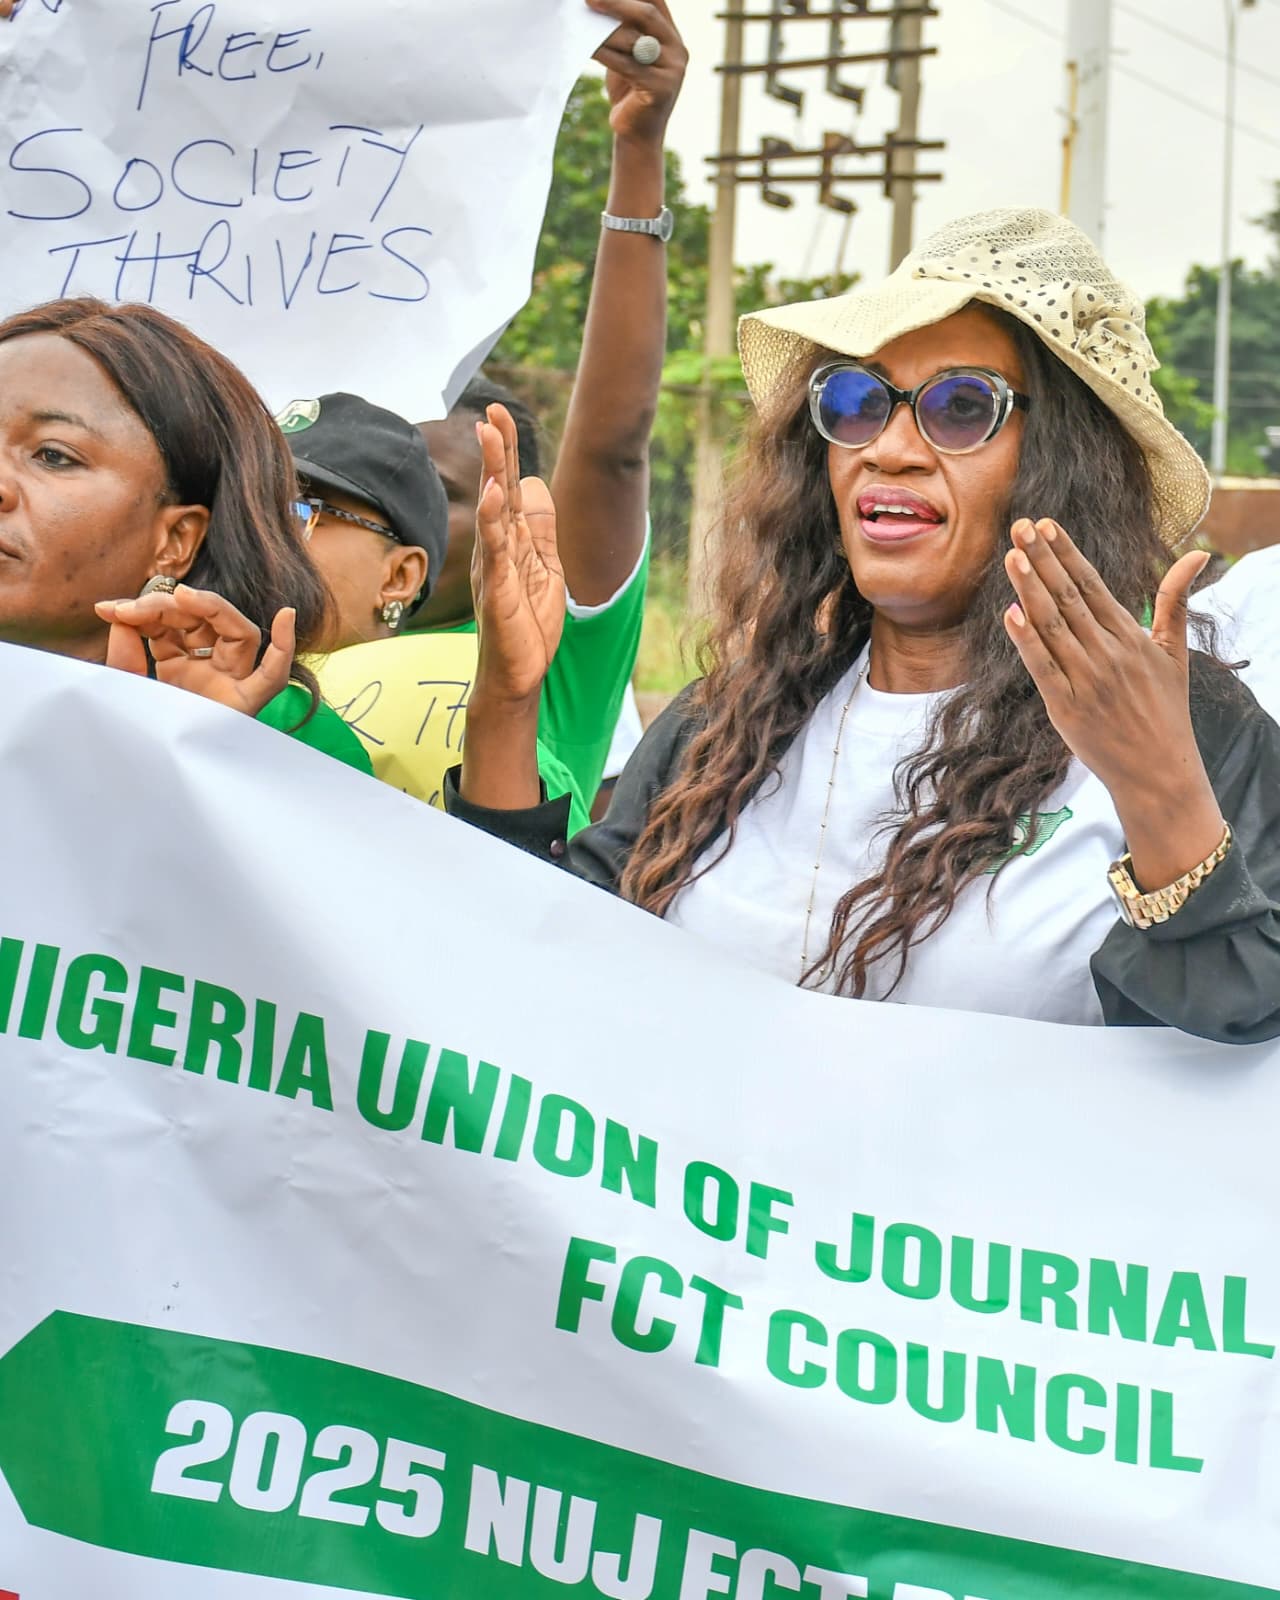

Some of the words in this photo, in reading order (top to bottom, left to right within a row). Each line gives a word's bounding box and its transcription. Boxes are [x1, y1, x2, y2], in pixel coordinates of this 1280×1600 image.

[7, 124, 424, 222] SOCIETY
[48, 219, 432, 310] THRIVES
[357, 1030, 659, 1208] UNION
[683, 1161, 794, 1259] OF
[556, 1237, 743, 1367] FCT
[767, 1309, 1203, 1473] COUNCIL
[150, 1400, 446, 1538] 2025
[464, 1464, 662, 1600] NUJ
